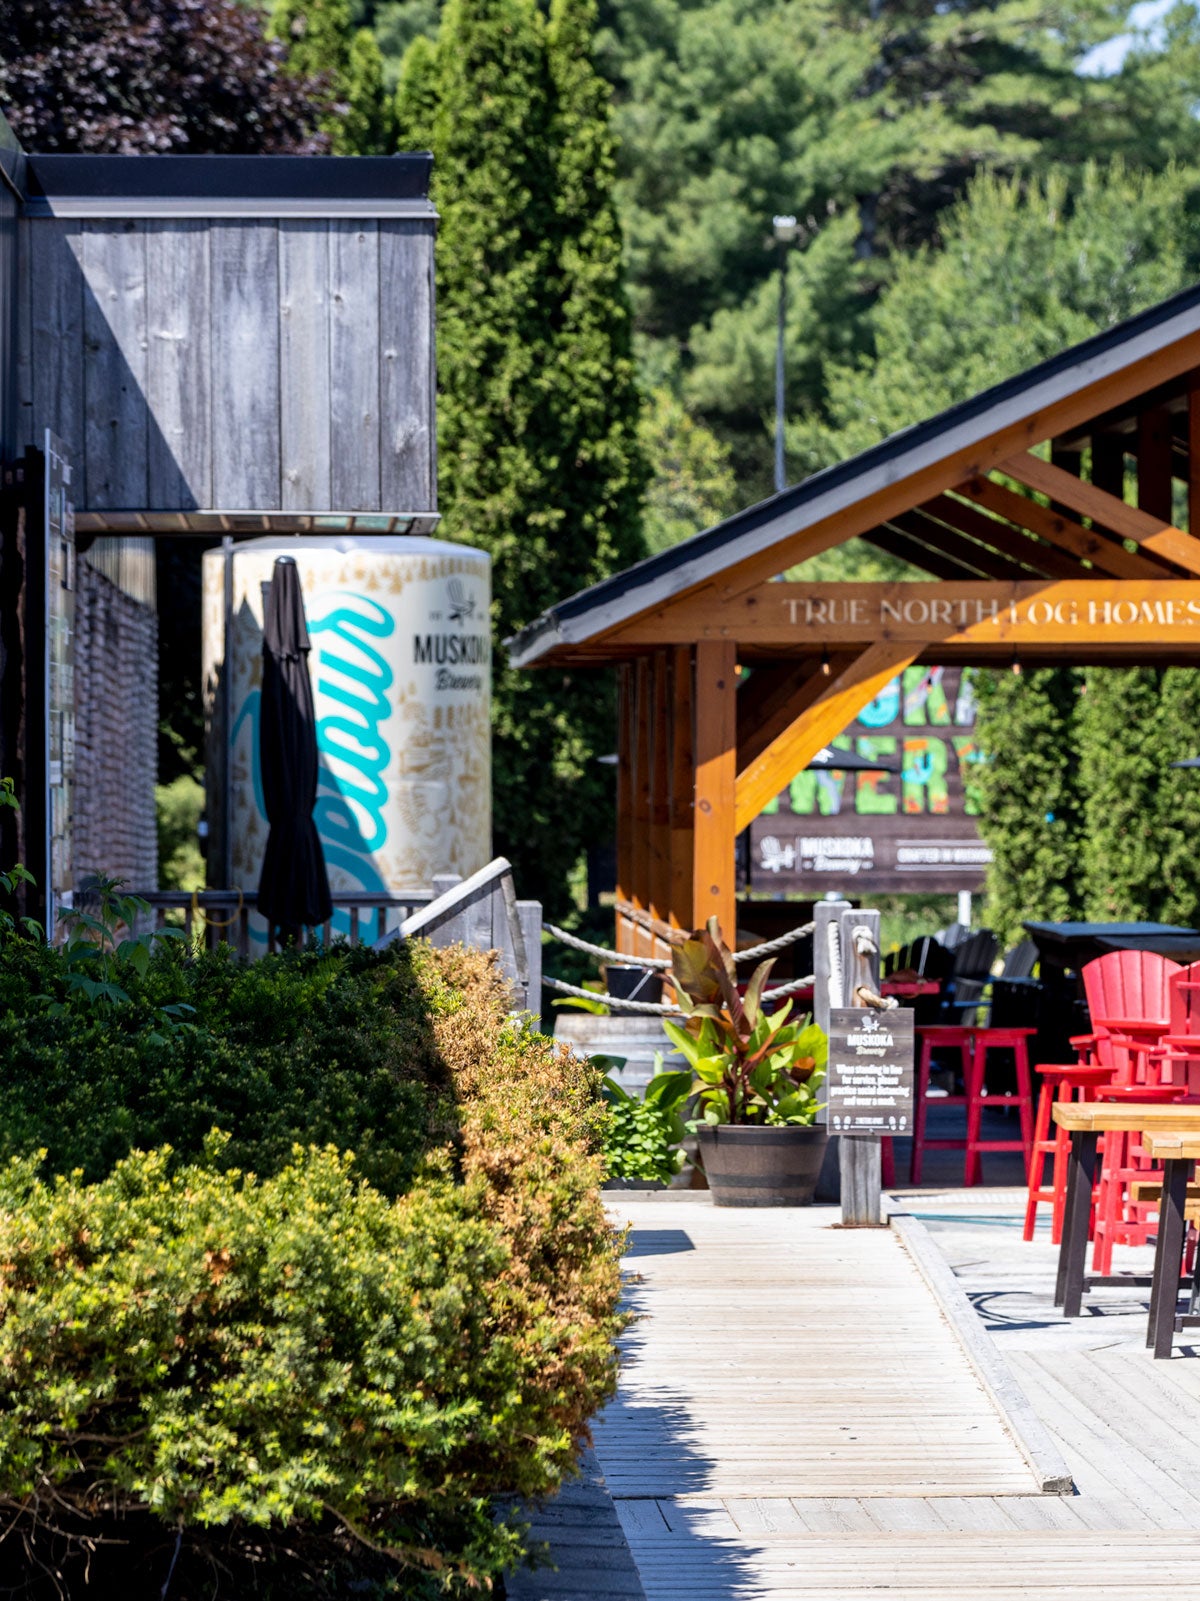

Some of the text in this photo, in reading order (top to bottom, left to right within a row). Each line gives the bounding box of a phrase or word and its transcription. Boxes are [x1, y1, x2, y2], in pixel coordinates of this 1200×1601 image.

[782, 599, 870, 625] TRUE
[880, 599, 999, 625] NORTH
[1010, 599, 1079, 625] LOG
[847, 1034, 894, 1047] MUSKOKA
